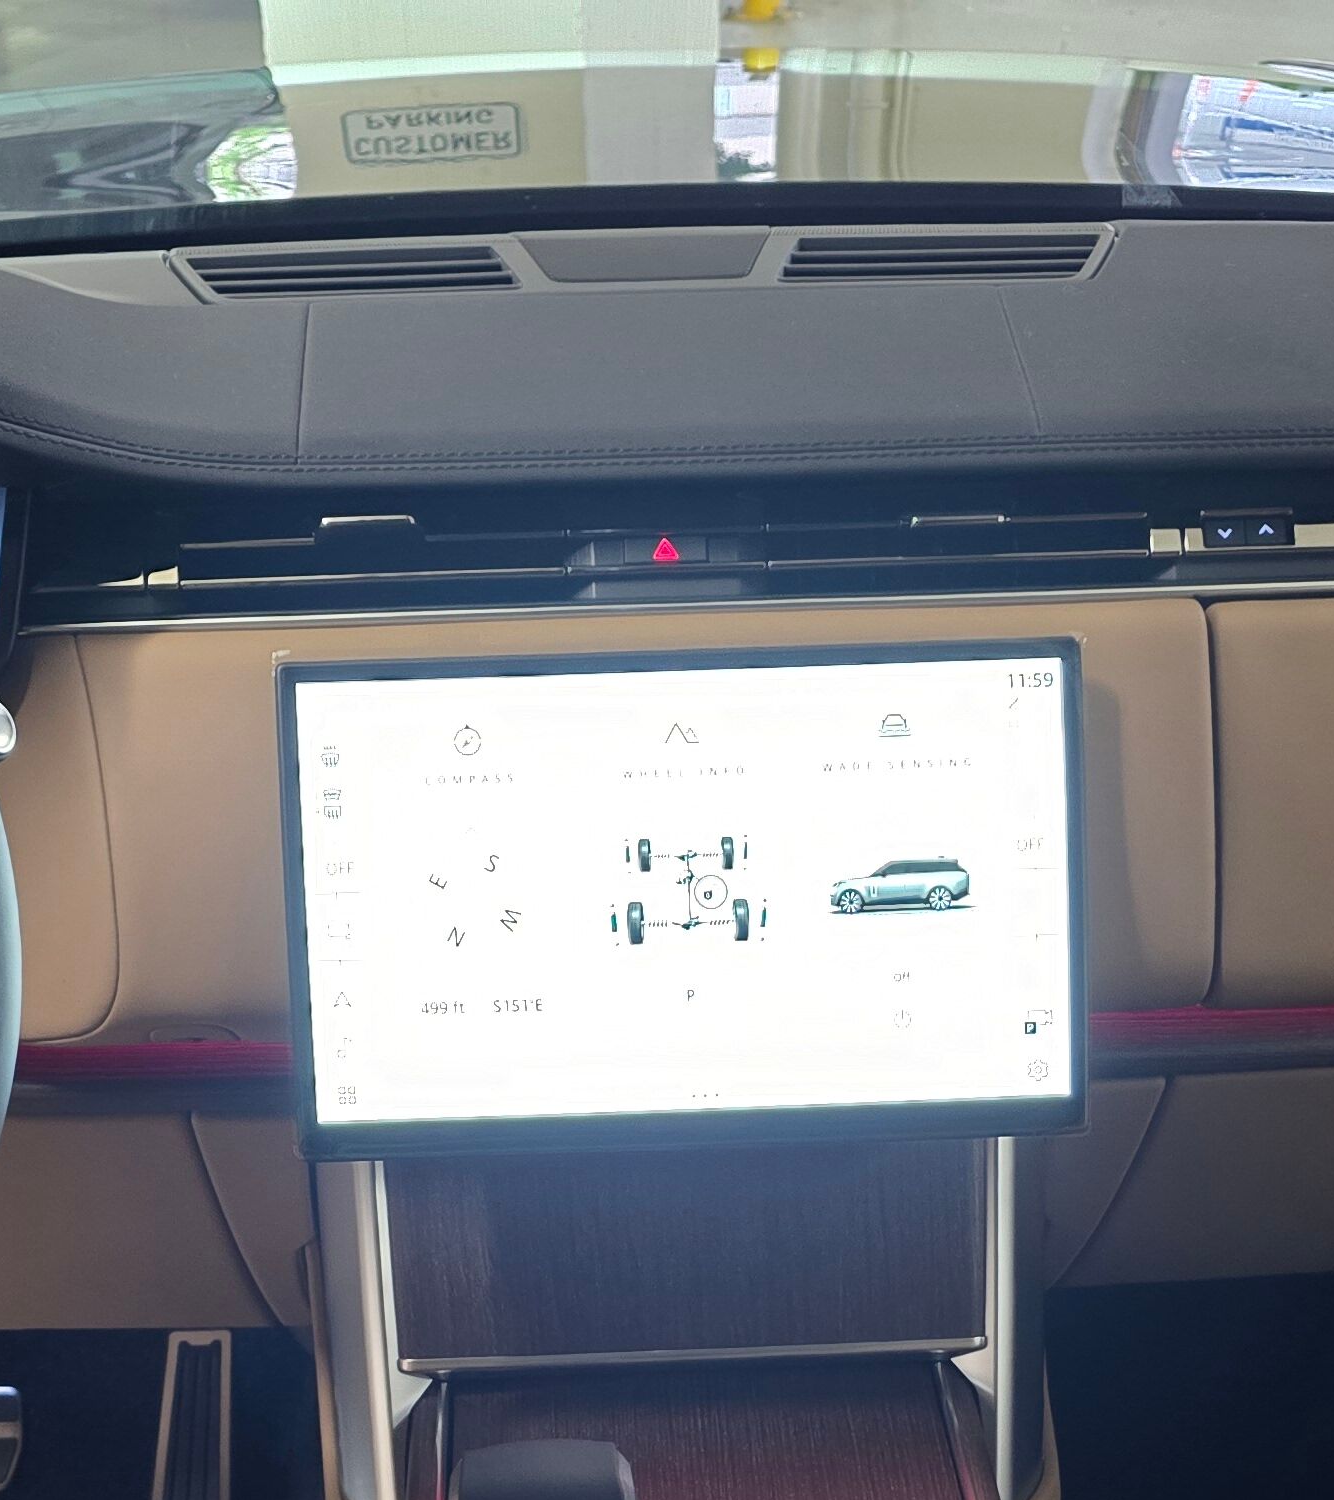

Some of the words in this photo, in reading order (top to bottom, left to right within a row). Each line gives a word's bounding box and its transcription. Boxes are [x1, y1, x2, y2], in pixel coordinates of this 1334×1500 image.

[1008, 672, 1054, 688] 11:59
[425, 773, 513, 786] COMPASS
[326, 861, 354, 876] OFF
[483, 854, 500, 872] S
[429, 873, 448, 890] E
[447, 926, 466, 947] N
[687, 989, 695, 1002] P
